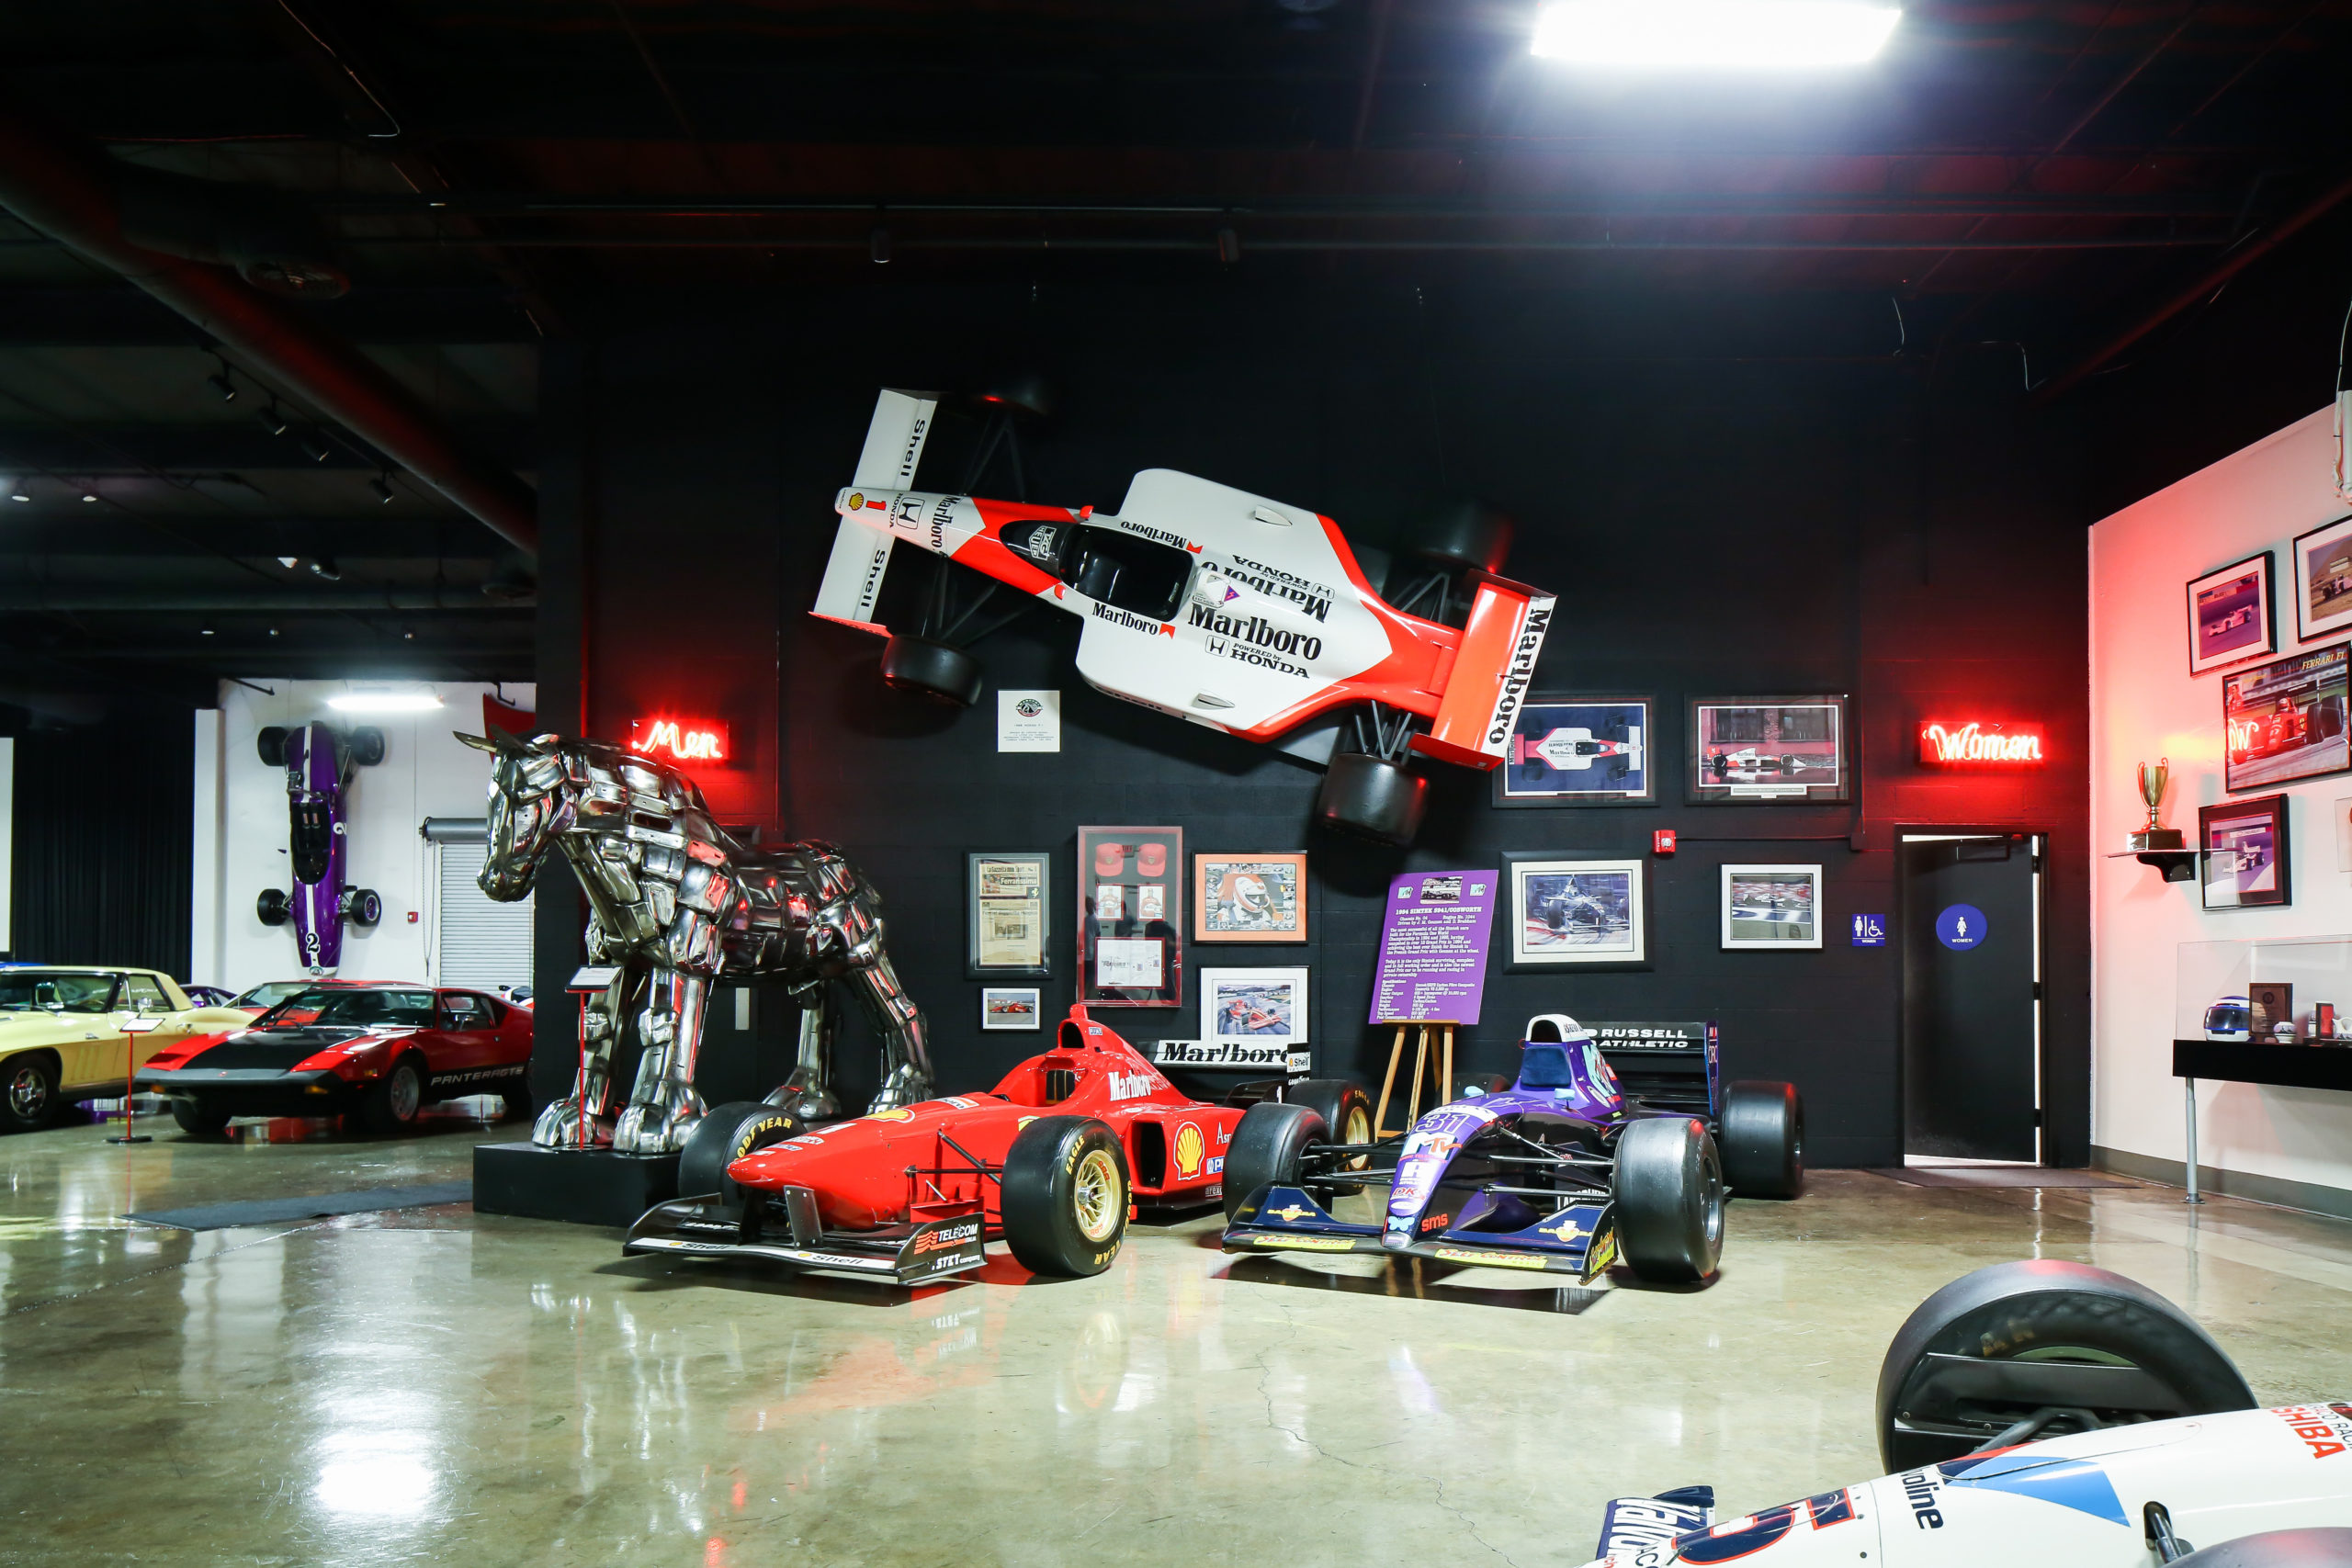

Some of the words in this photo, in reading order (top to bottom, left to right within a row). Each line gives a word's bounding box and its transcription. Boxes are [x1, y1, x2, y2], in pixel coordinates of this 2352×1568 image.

[899, 419, 926, 478] Shell
[865, 501, 887, 511] 1
[889, 492, 903, 528] HONDA
[931, 495, 961, 548] Marlboro
[1120, 520, 1187, 549] Marlboro
[861, 549, 886, 607] Shell
[1233, 555, 1311, 587] HONDA
[1091, 603, 1159, 636] Marlboro
[1188, 603, 1322, 660] Marlboro
[1230, 649, 1309, 679] HONDA
[1233, 643, 1272, 658] POWERED
[2301, 654, 2334, 670] FERRARI
[1488, 608, 1552, 745] Marlboro
[632, 720, 722, 759] Men
[1928, 723, 2042, 761] Women
[306, 932, 321, 953] 2
[1600, 1040, 1689, 1048] ATHLETIC
[1601, 1029, 1688, 1039] RUSSELL
[1161, 1042, 1288, 1064] Marlboro
[1108, 1069, 1152, 1101] Marlboro
[1066, 1134, 1085, 1176] EAGLE
[939, 1224, 978, 1242] TELECOM
[1421, 1213, 1449, 1233] sms
[812, 1255, 864, 1265] Shell
[936, 1254, 961, 1269] STET
[1607, 1498, 1706, 1556] Valvo
